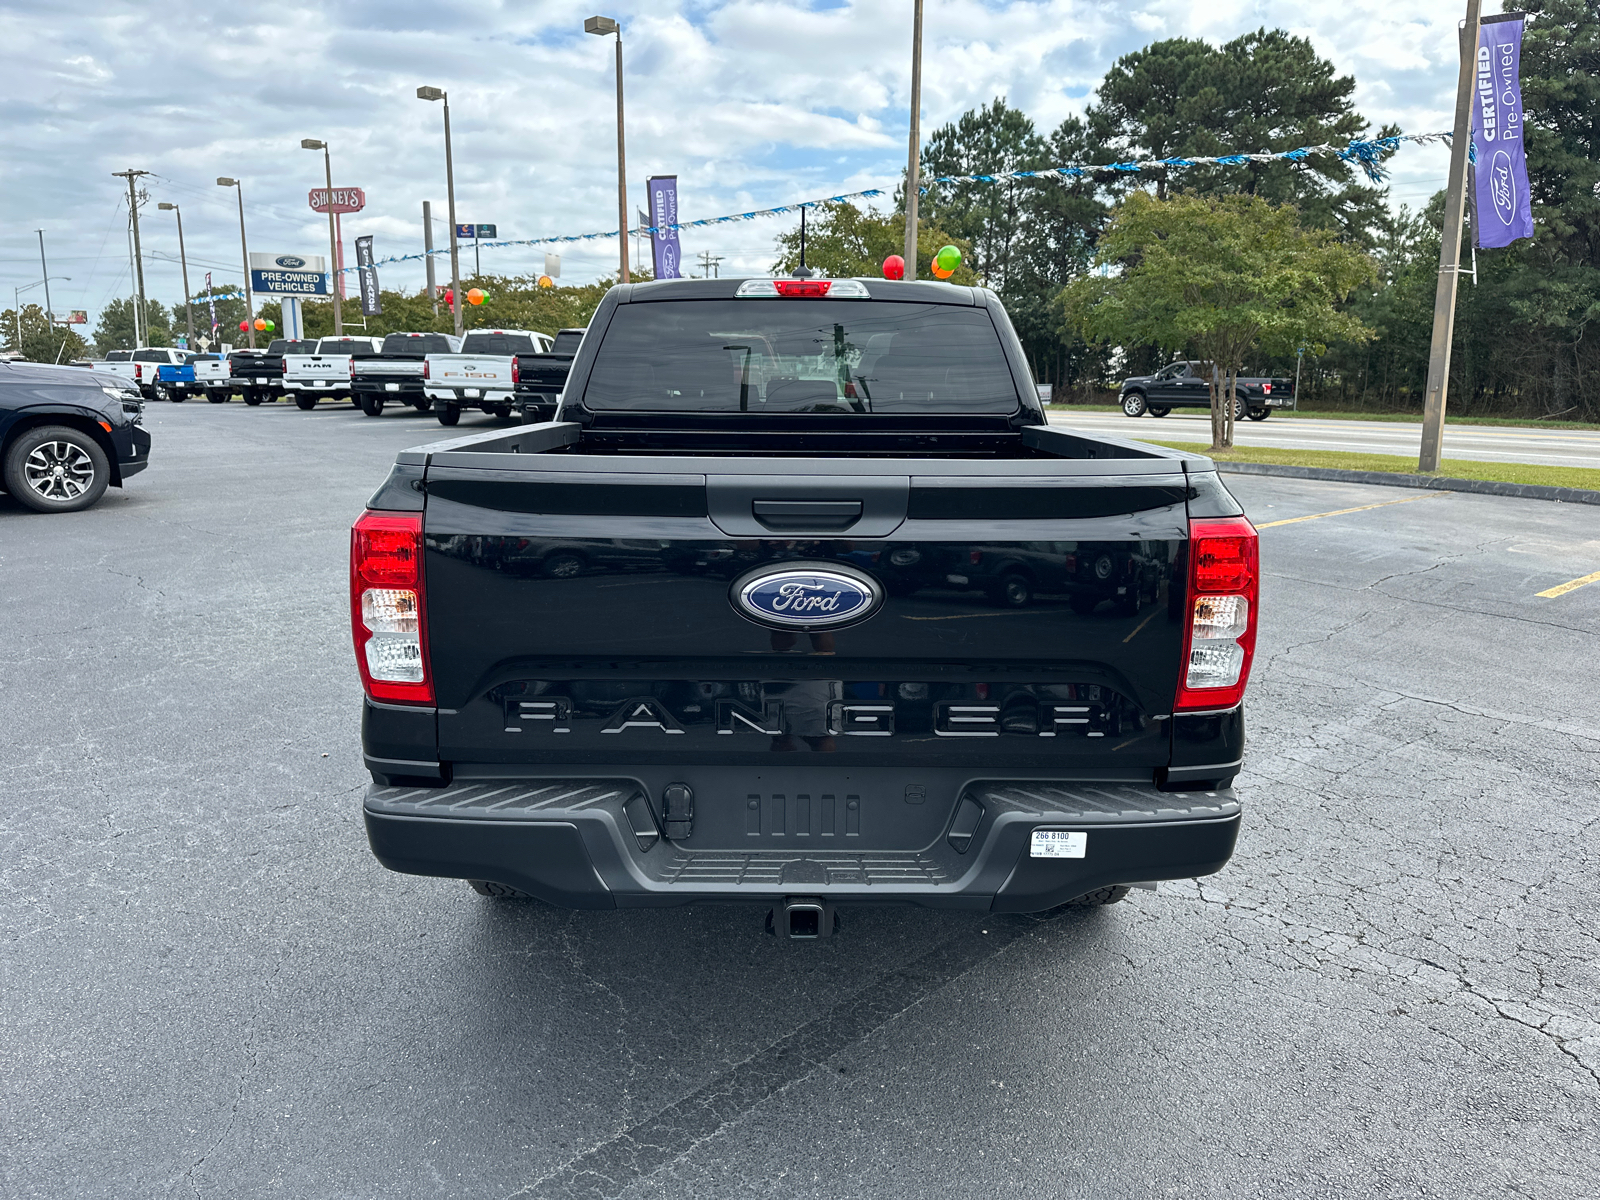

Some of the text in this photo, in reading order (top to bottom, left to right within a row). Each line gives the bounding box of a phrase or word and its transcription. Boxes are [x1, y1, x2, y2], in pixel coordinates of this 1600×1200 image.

[1478, 46, 1497, 142] CERTIFIED
[1497, 42, 1519, 141] Pre-Owned
[1493, 166, 1512, 211] Ford
[282, 258, 301, 267] Ford
[666, 253, 675, 275] Ford
[261, 272, 320, 283] PRE-OWNED
[267, 282, 316, 292] VEHICLES
[365, 272, 376, 311] CHANGE
[444, 371, 497, 379] F-150
[772, 582, 842, 612] Ford
[503, 697, 1106, 737] RANGER
[1051, 832, 1069, 840] 8100
